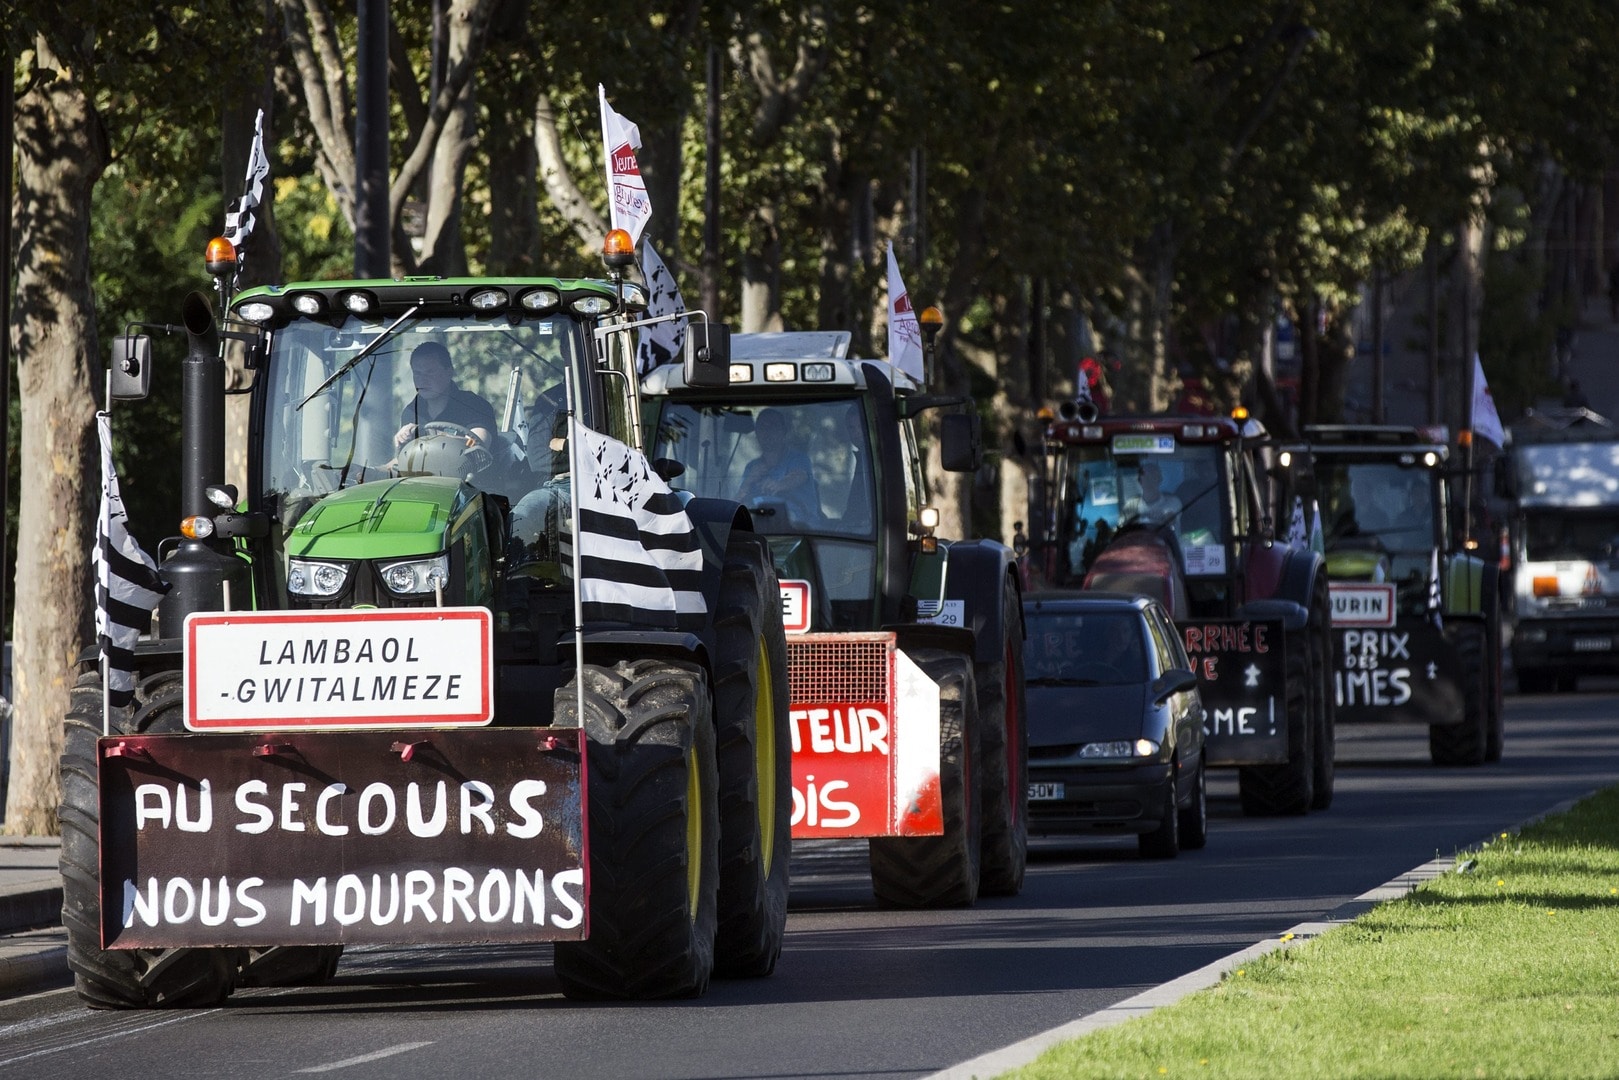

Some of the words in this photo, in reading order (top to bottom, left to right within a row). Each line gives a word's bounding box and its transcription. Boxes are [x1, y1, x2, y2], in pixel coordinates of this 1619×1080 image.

[941, 614, 957, 625] 29
[1331, 598, 1383, 614] URIN
[259, 636, 420, 666] LAMBAOL
[1344, 630, 1410, 660] PRIX
[1345, 653, 1379, 669] DES
[1334, 667, 1412, 707] IMES
[789, 706, 889, 756] TEUR
[135, 778, 213, 833] AU
[235, 779, 548, 840] SECOURS
[123, 876, 267, 929] NOUS
[289, 867, 584, 930] MOURRONS
